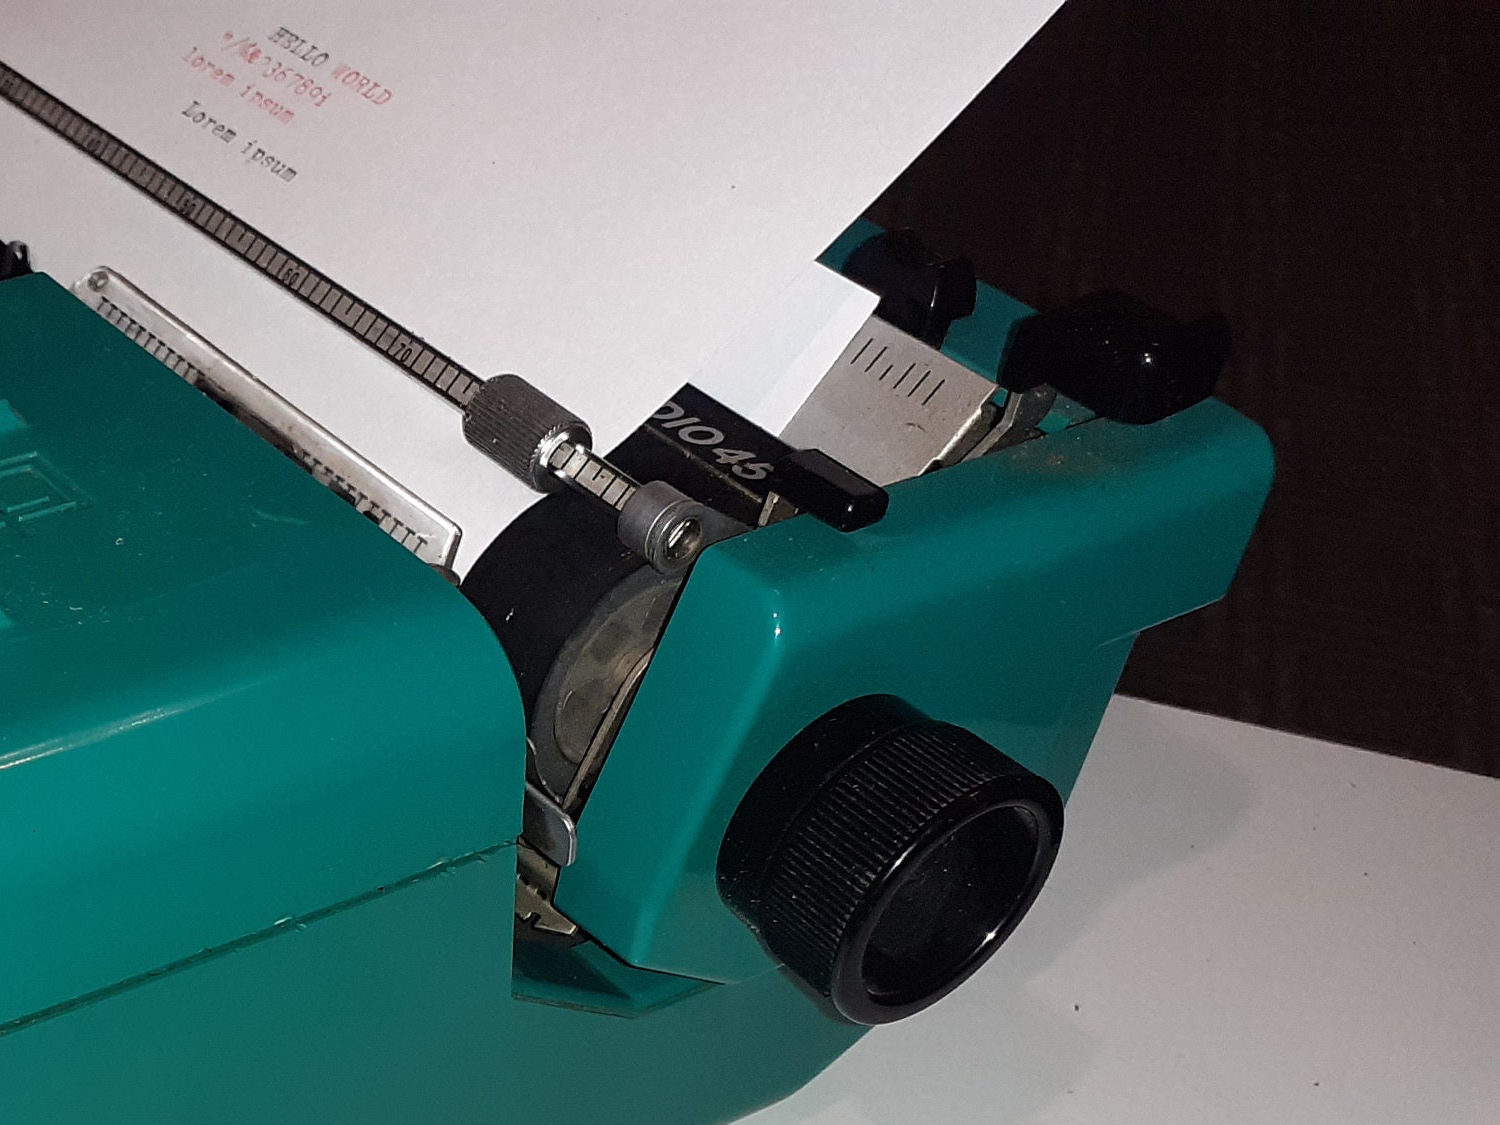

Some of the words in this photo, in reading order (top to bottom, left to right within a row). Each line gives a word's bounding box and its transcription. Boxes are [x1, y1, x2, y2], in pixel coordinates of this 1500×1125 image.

[182, 46, 236, 87] lorem
[239, 83, 295, 124] ipsum
[268, 27, 330, 67] HELLO
[331, 64, 393, 106] WORLD
[181, 100, 237, 143] Lorem
[240, 140, 297, 182] ipsum
[395, 342, 413, 363] 70
